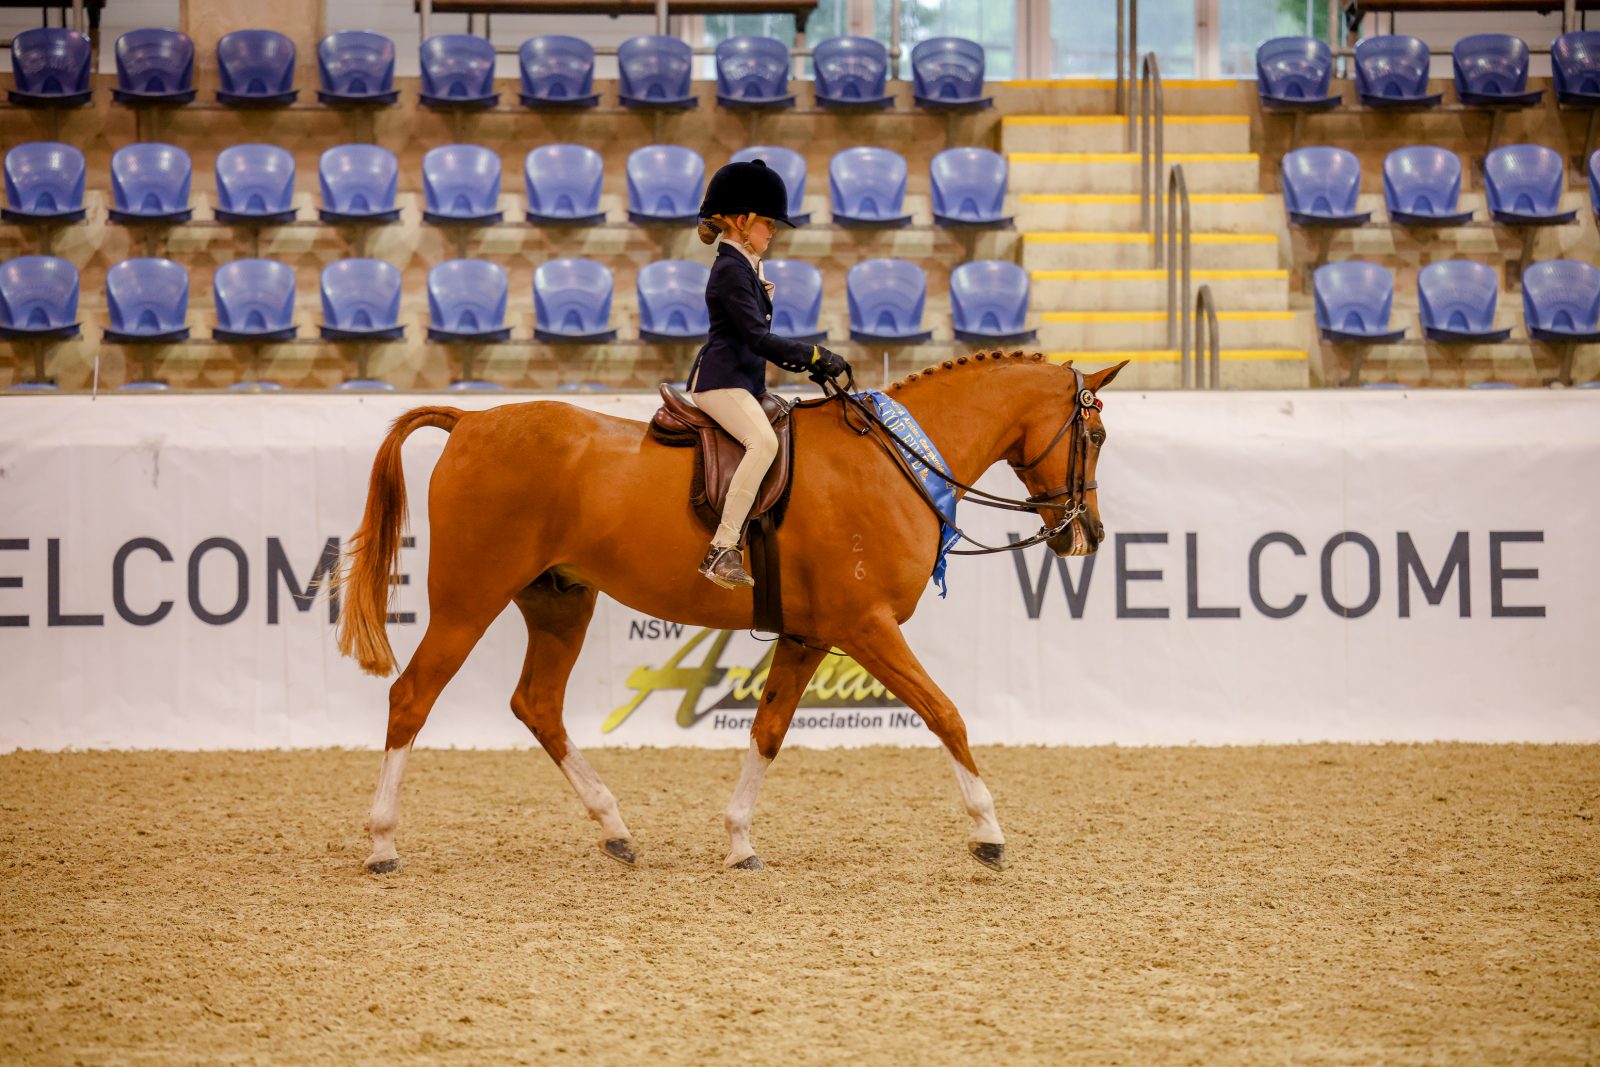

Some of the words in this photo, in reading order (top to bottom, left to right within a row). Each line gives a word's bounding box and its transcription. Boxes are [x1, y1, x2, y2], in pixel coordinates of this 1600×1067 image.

[852, 534, 864, 552] 2
[855, 561, 866, 580] 6
[1007, 532, 1546, 619] WELCOME
[0, 536, 416, 627] ELCOME
[629, 620, 685, 639] NSW
[714, 714, 754, 729] Hors
[790, 713, 882, 729] ssociation
[889, 713, 923, 729] INC
